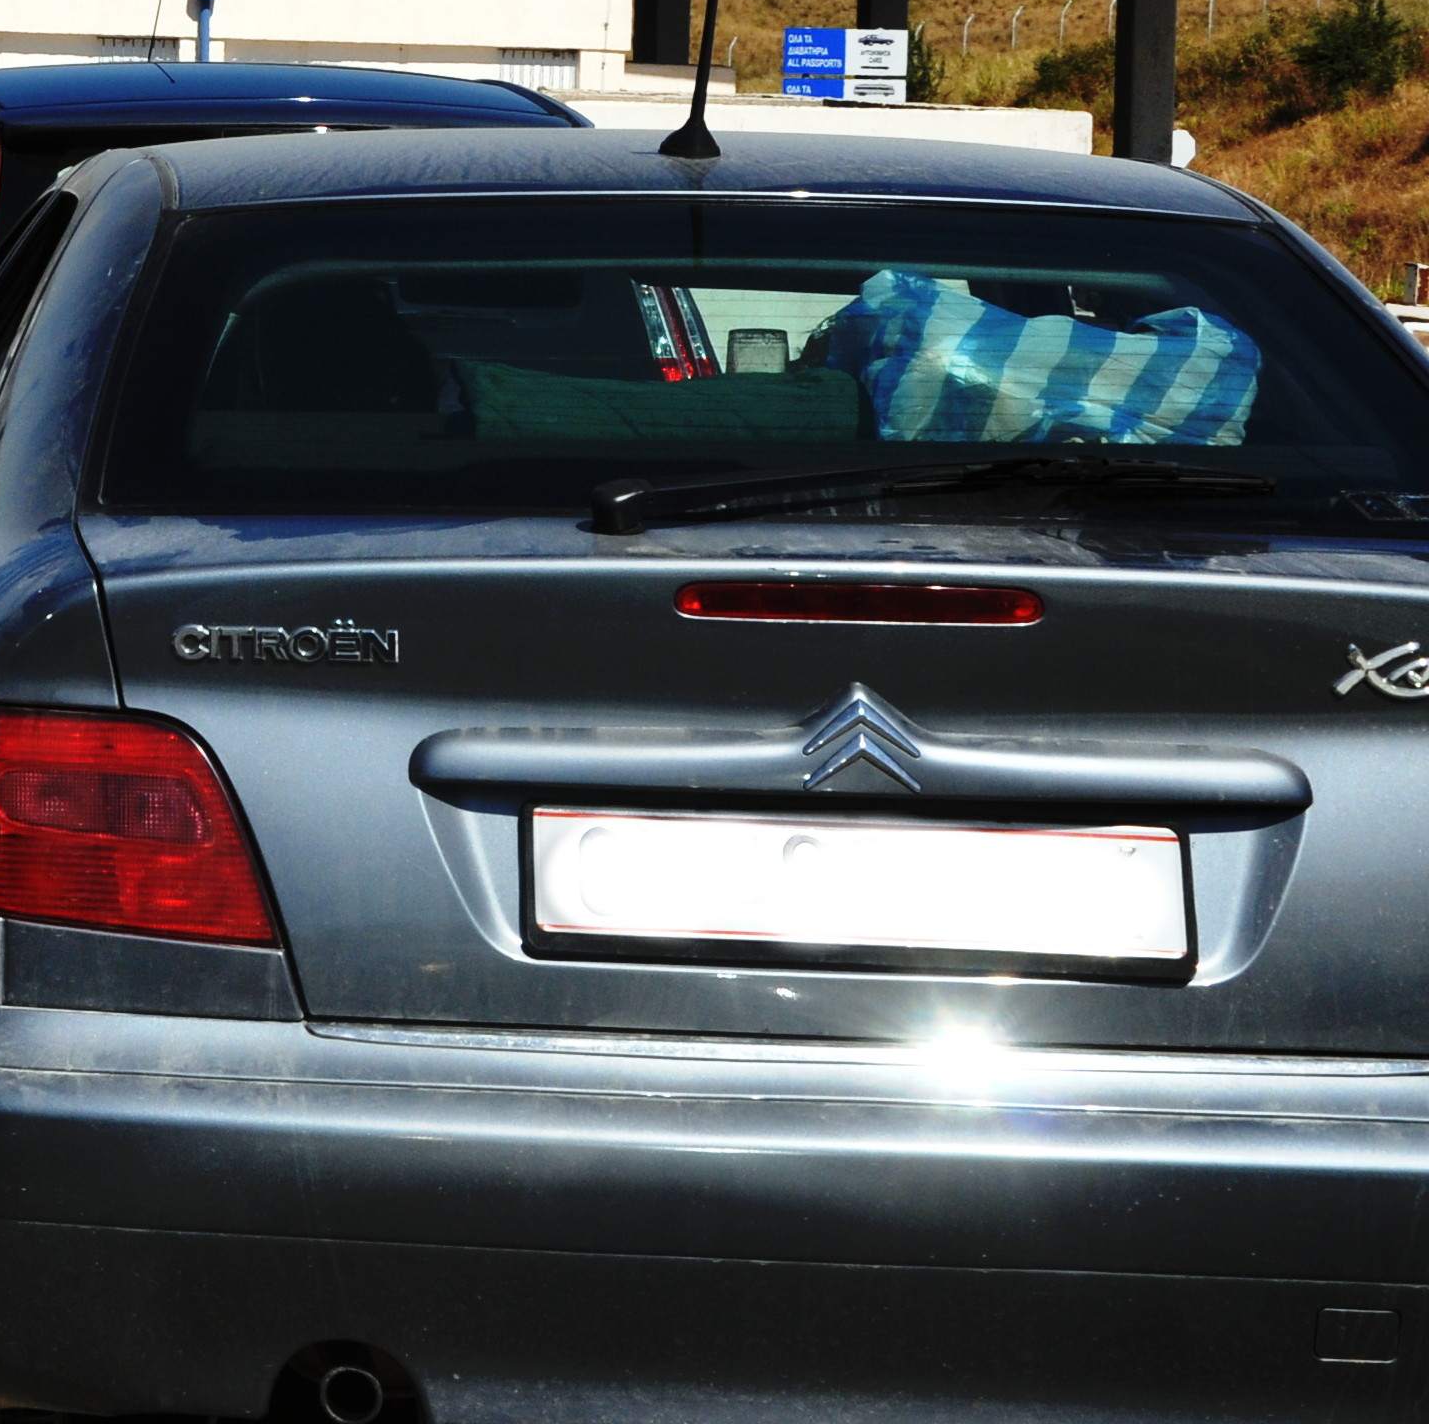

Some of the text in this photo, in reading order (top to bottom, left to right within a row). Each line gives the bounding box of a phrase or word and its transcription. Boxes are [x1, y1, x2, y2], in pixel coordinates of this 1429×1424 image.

[787, 58, 843, 68] ALL PASSPORTS
[172, 618, 400, 664] CITROËN
